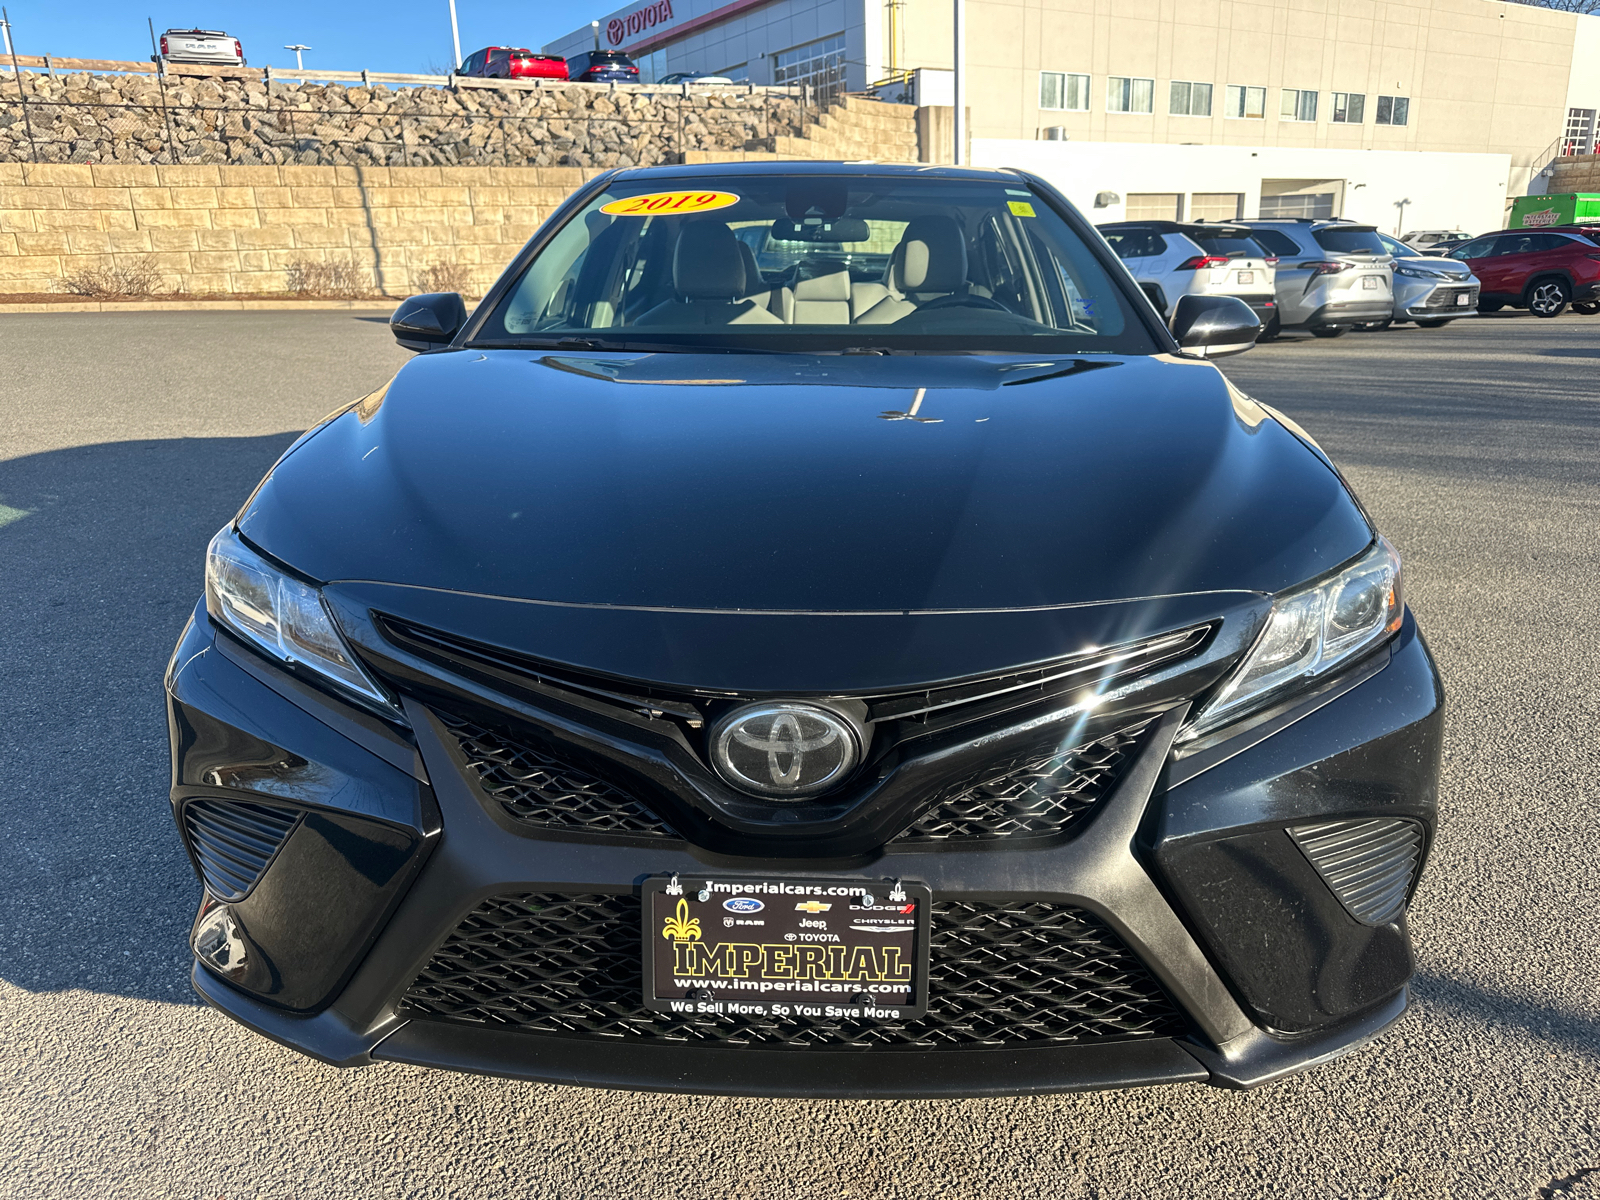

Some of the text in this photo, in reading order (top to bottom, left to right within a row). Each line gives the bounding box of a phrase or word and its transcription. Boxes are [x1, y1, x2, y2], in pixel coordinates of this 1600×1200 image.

[623, 0, 673, 36] TOYOTA
[621, 194, 717, 212] 2019
[705, 881, 866, 897] Imperialcars.com
[732, 901, 755, 910] Ford
[799, 918, 827, 930] Jeep
[799, 933, 840, 942] TOYOTA
[673, 942, 912, 982] IMPERIAL
[674, 979, 911, 994] www.imperialcars.com
[670, 1001, 899, 1018] We Sell More, So You Save More
